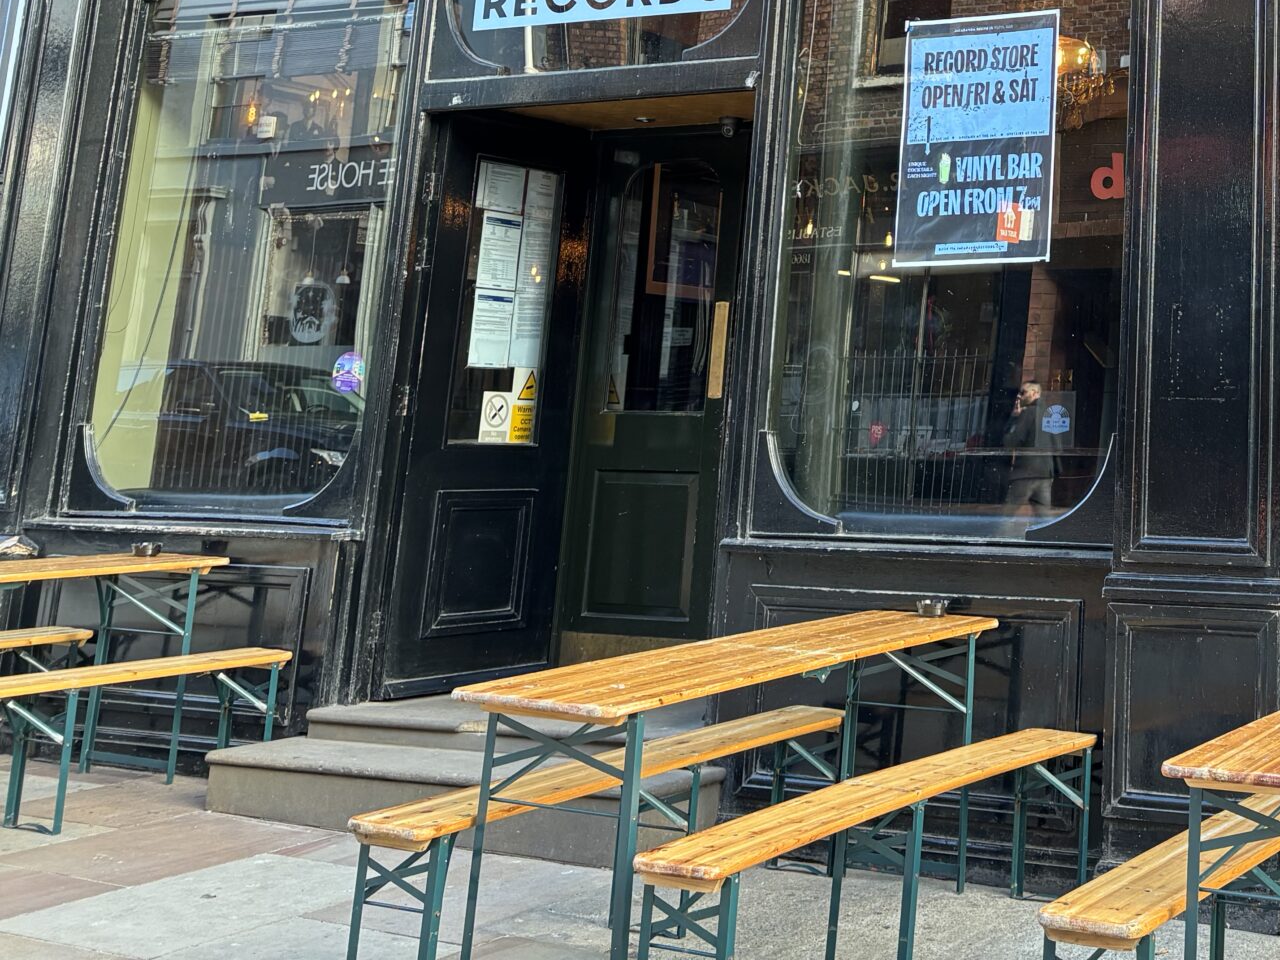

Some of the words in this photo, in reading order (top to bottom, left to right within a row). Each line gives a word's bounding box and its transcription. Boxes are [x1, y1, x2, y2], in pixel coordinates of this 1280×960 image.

[924, 49, 989, 75] RECORD
[990, 43, 1039, 70] STORE
[921, 84, 963, 109] OPEN
[963, 82, 990, 107] FRI
[992, 83, 1006, 105] &
[1009, 77, 1039, 103] SAT
[956, 155, 1004, 182] VINYL
[1007, 153, 1043, 180] BAR
[917, 189, 960, 217] OPEN
[964, 187, 1014, 215] FROM
